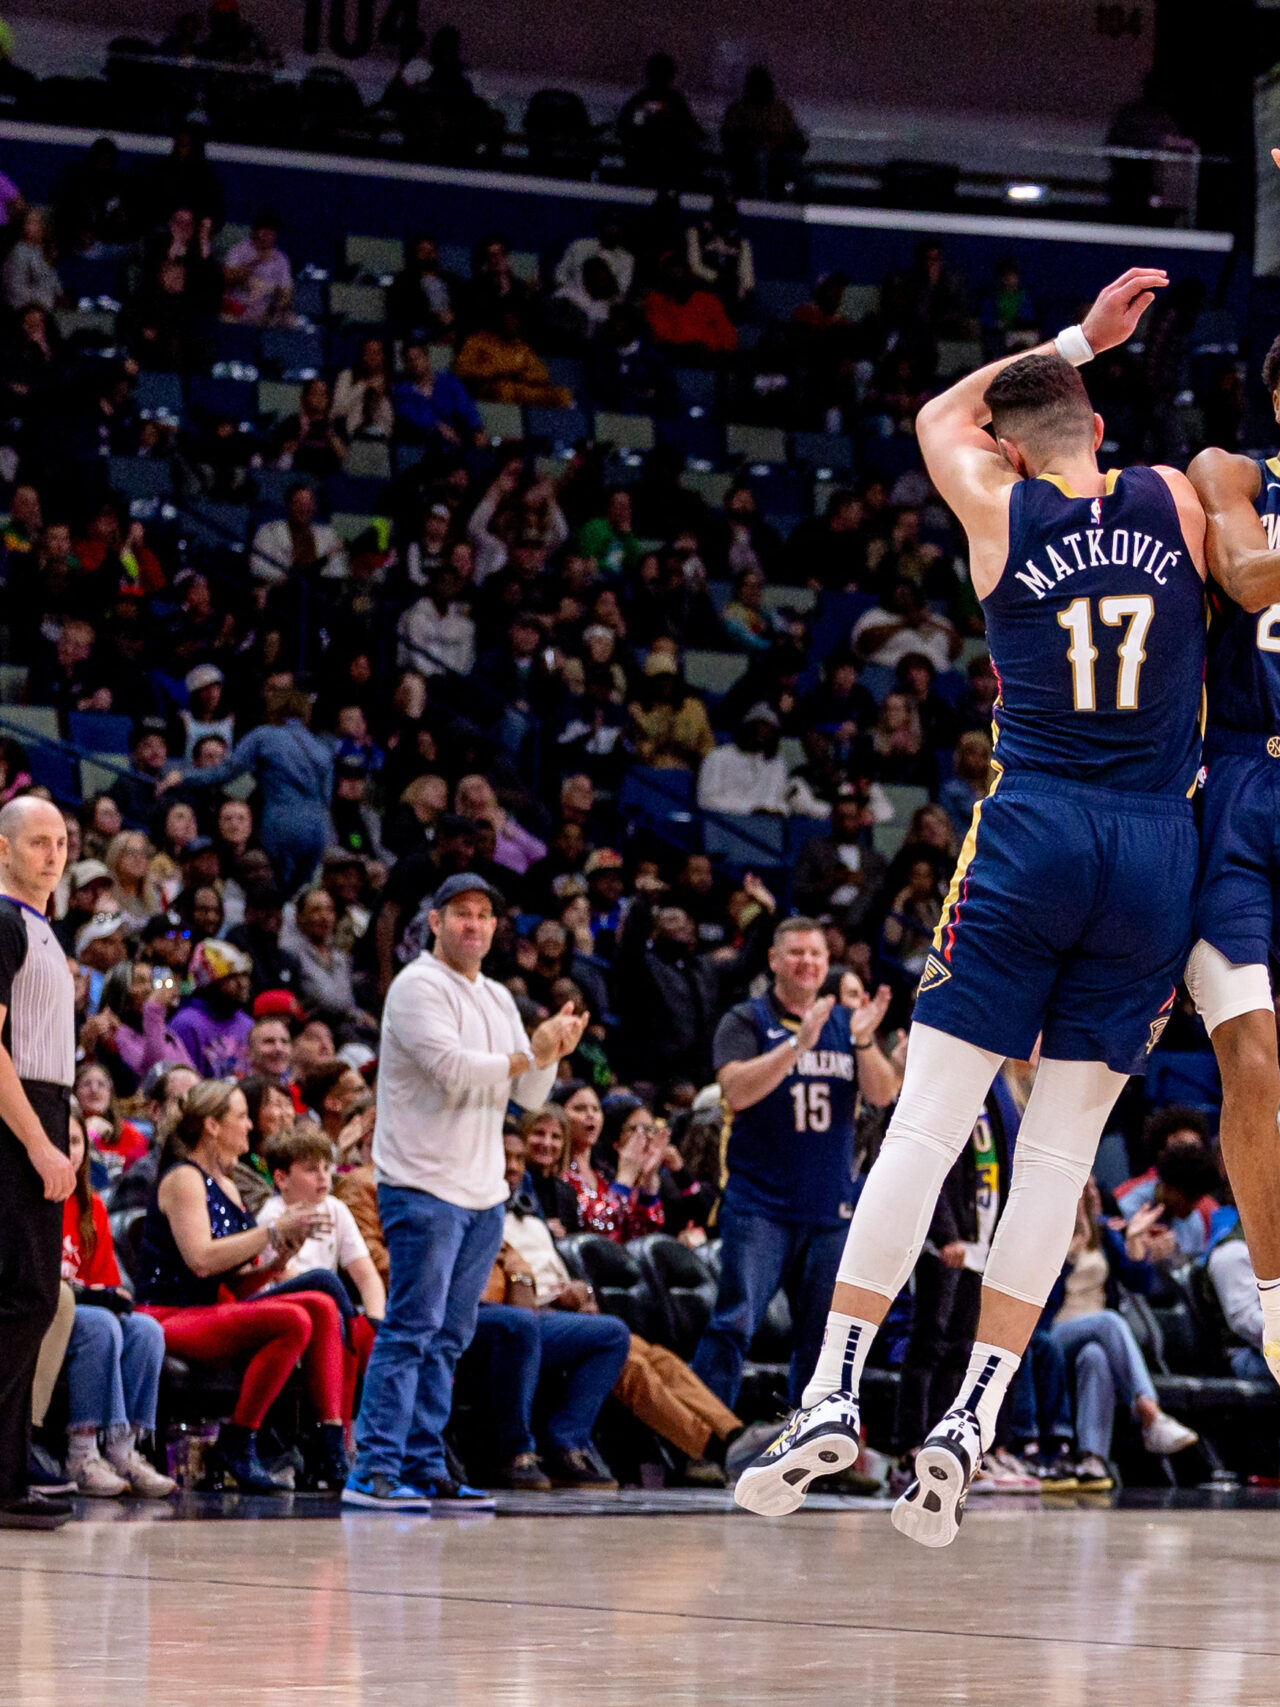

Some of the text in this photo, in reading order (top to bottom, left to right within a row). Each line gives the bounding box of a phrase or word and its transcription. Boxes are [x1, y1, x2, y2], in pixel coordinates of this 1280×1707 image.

[303, 0, 424, 60] 104
[1014, 529, 1182, 600] MATKOVIĆ
[1057, 594, 1155, 712] 17
[789, 1082, 832, 1133] 15
